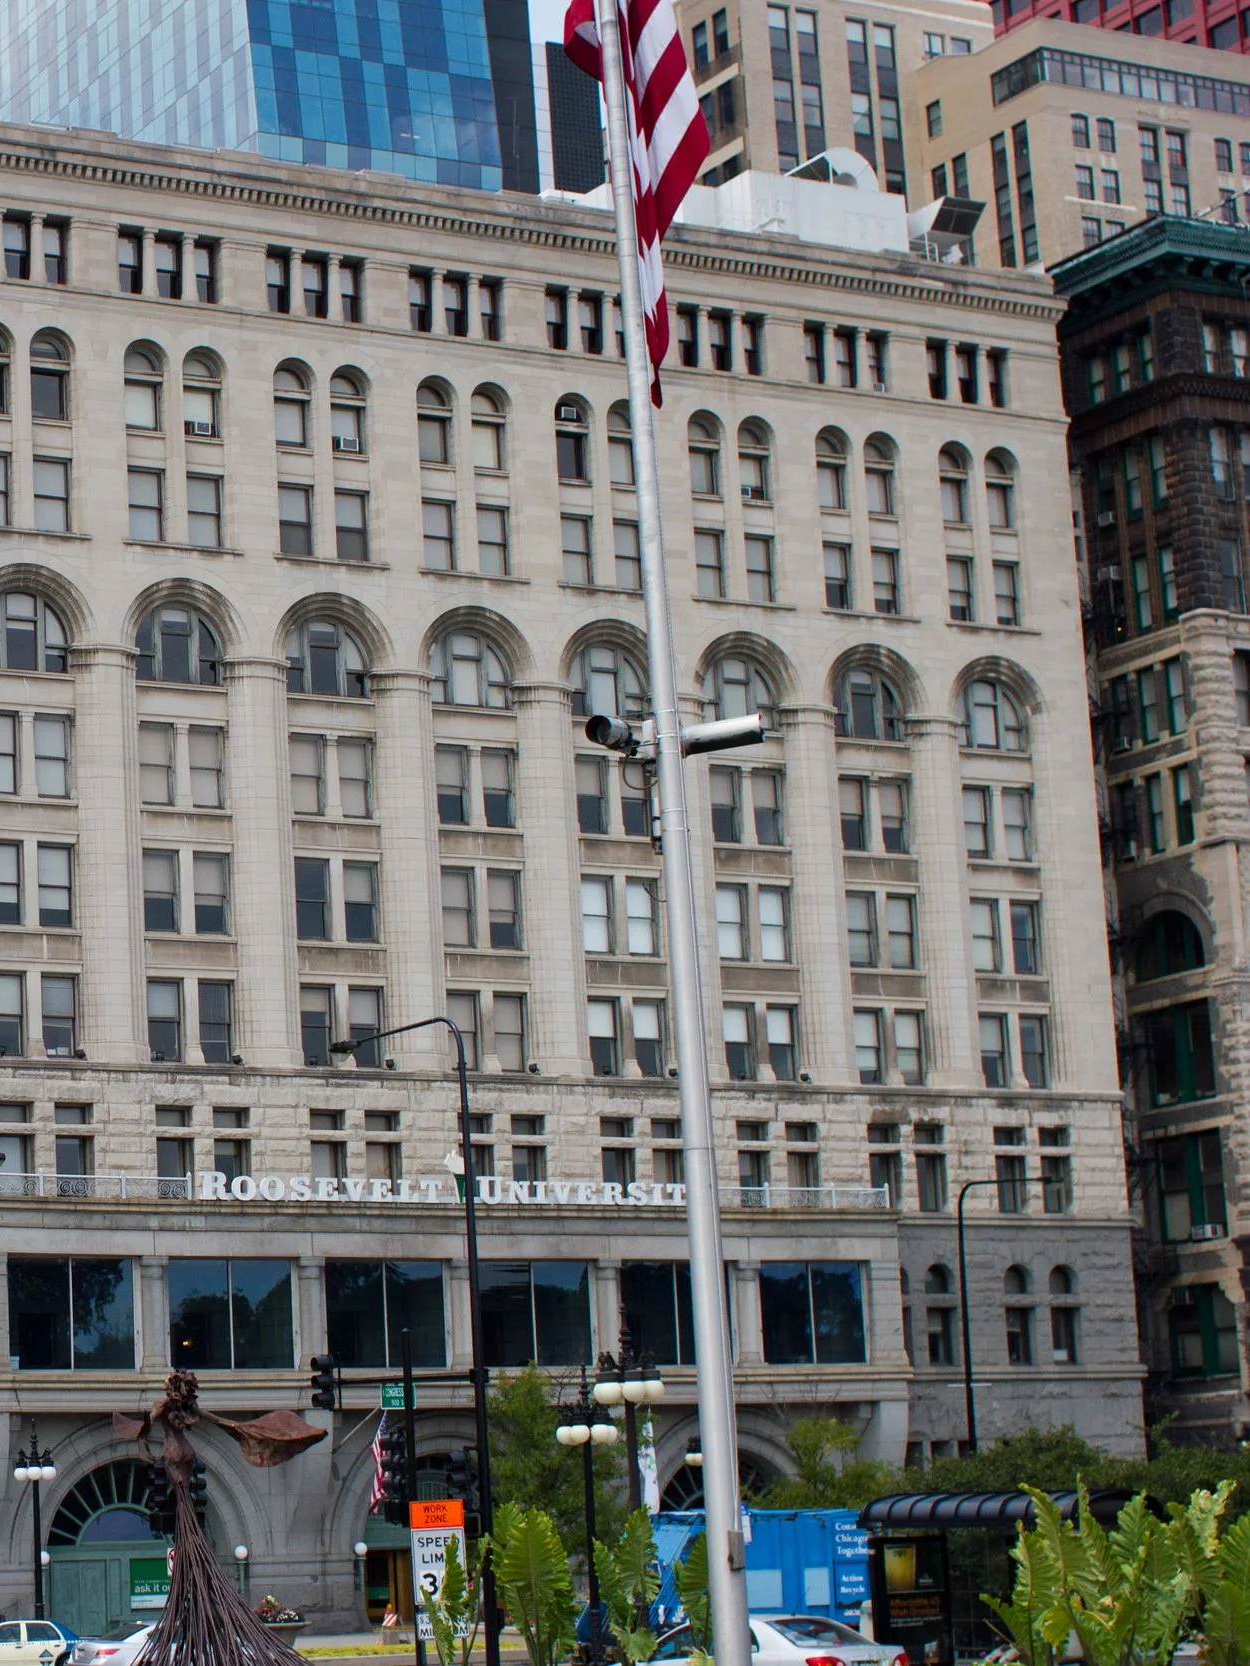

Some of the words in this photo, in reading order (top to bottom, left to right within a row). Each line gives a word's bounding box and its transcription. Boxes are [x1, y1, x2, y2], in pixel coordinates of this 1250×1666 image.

[200, 1171, 443, 1203] ROOSEVELT
[476, 1175, 687, 1206] UNIVERSIT
[423, 1504, 447, 1514] WORK
[425, 1514, 448, 1524] ZONE
[422, 1553, 445, 1564] LIM
[134, 1584, 151, 1593] ask
[153, 1583, 160, 1592] it
